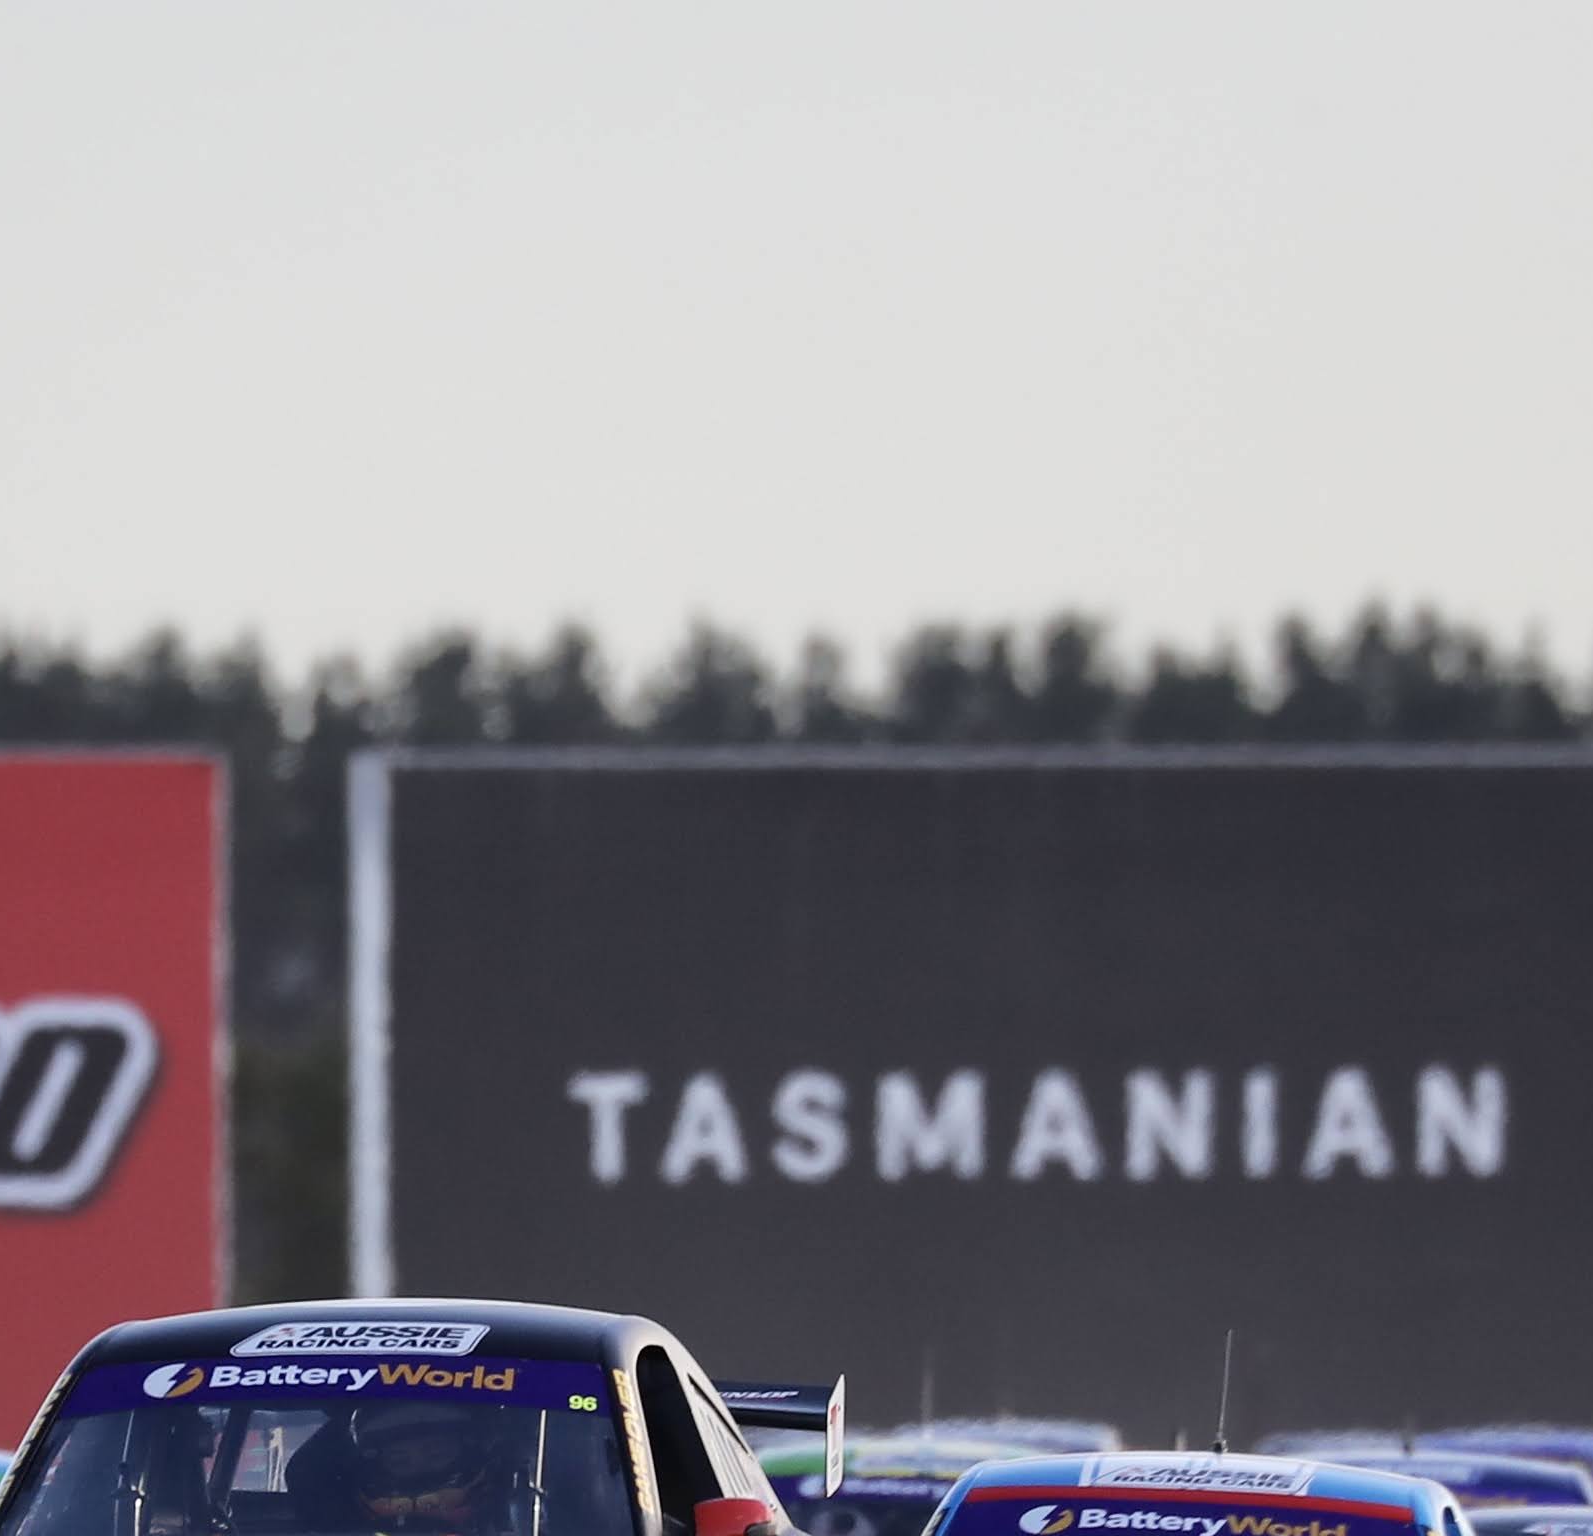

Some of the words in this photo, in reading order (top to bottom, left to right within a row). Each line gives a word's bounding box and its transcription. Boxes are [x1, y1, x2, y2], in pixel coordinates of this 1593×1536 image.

[567, 1067, 1508, 1183] TASMANIAN
[302, 1326, 470, 1339] AUSSIE
[255, 1338, 372, 1350] RACING
[379, 1338, 460, 1350] CARS
[718, 1390, 800, 1400] UNLOP
[568, 1395, 598, 1412] 96
